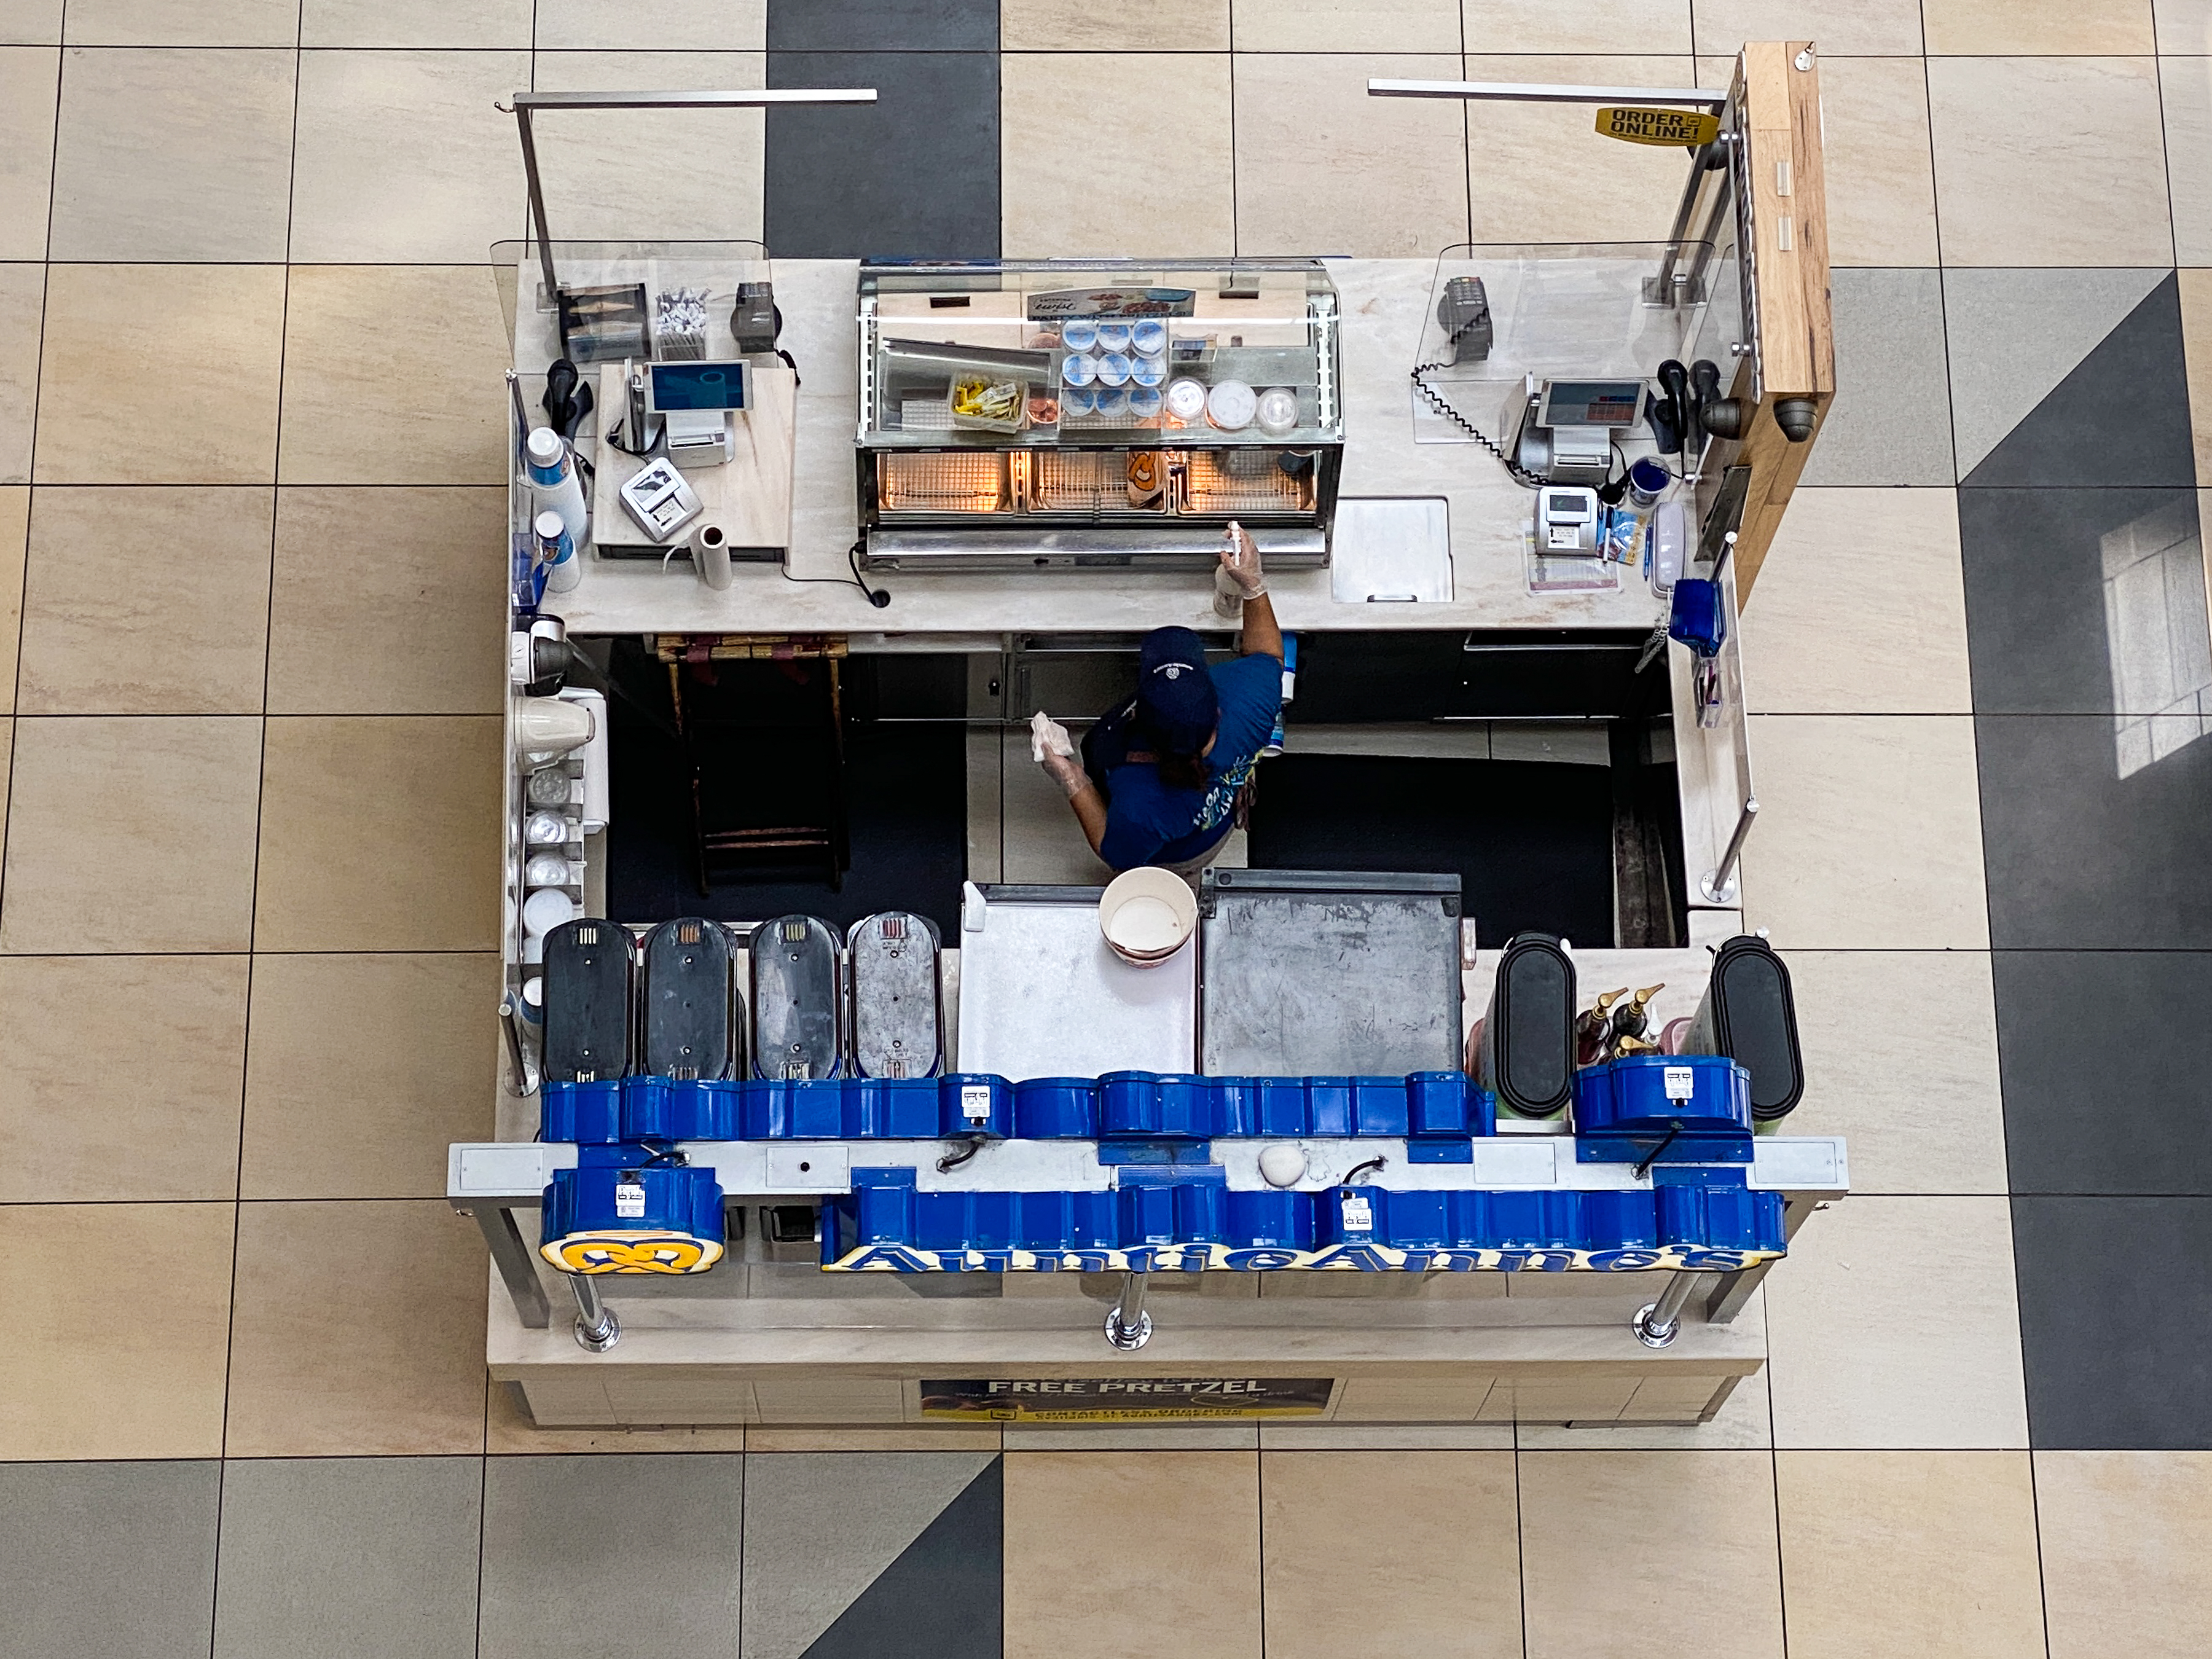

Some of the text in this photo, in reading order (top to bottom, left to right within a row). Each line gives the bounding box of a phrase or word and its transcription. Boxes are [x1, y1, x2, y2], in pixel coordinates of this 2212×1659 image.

[1612, 109, 1683, 125] ORDER
[1610, 121, 1698, 139] ONLINE!
[848, 1244, 1745, 1272] Auntie Anne's
[988, 1380, 1268, 1394] FREE PRETZEL
